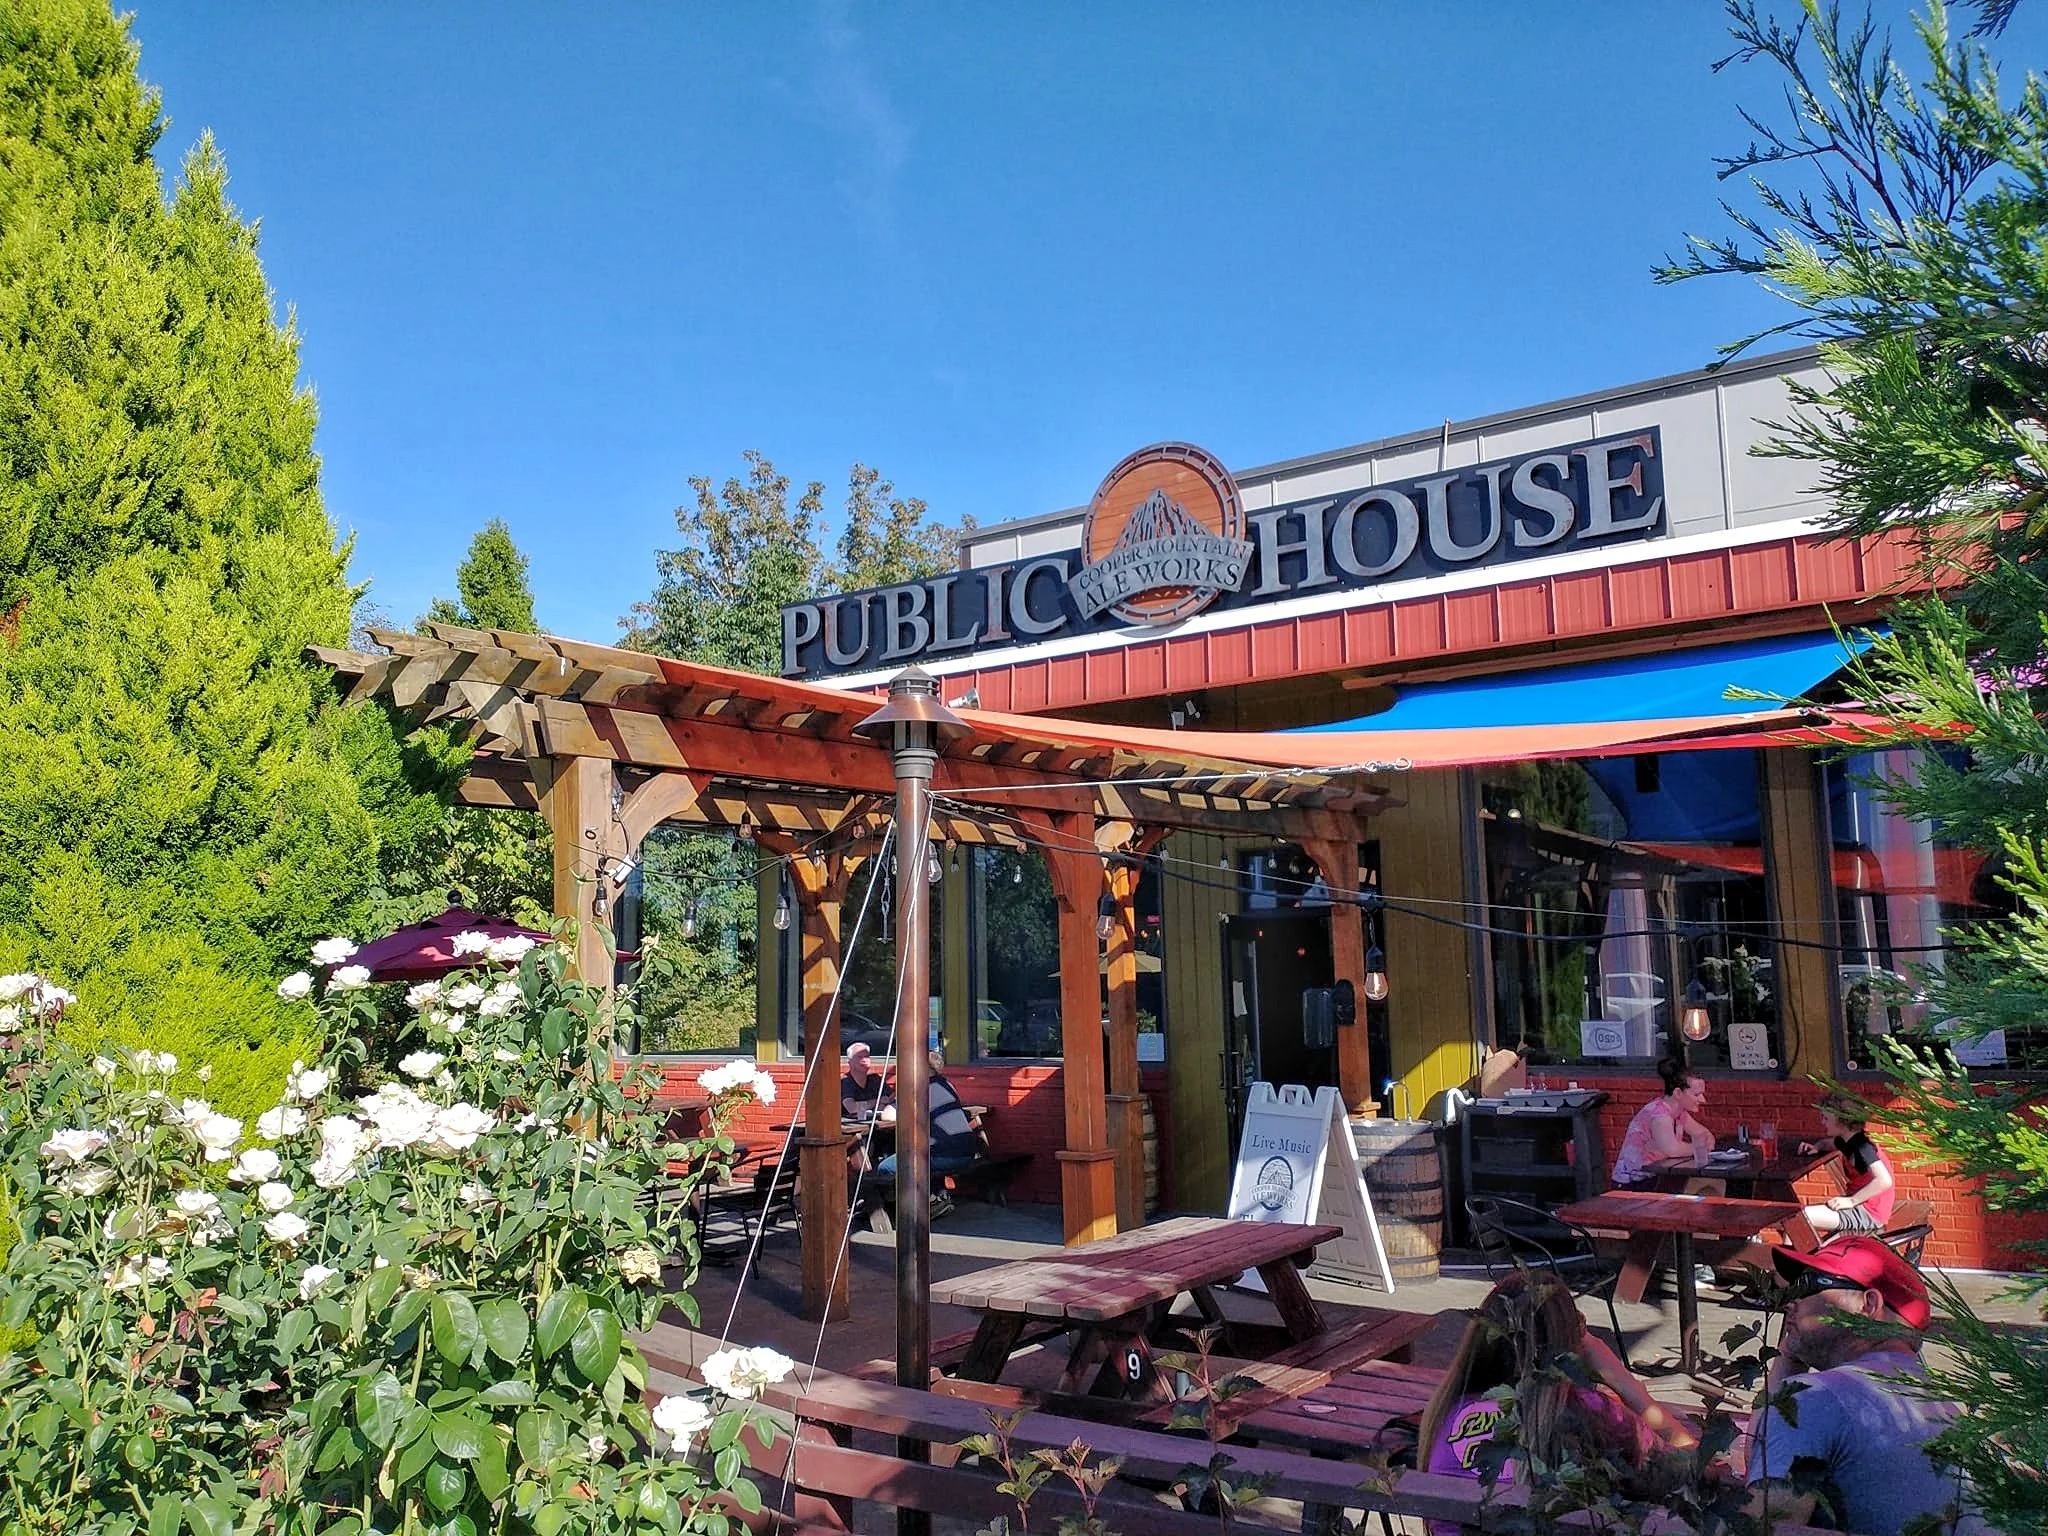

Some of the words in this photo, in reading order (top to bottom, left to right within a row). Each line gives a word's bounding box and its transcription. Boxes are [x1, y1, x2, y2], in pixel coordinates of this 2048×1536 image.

[781, 557, 1070, 677] PUBLIC
[1250, 433, 1662, 597] HOUSE
[1079, 547, 1144, 590] COOPER
[1146, 536, 1246, 560] MOUNTAIN
[1085, 570, 1131, 614] ALE
[1133, 558, 1240, 587] WORKS
[1252, 1134, 1276, 1150] Live
[1278, 1137, 1312, 1154] Music
[1128, 1353, 1141, 1380] 9
